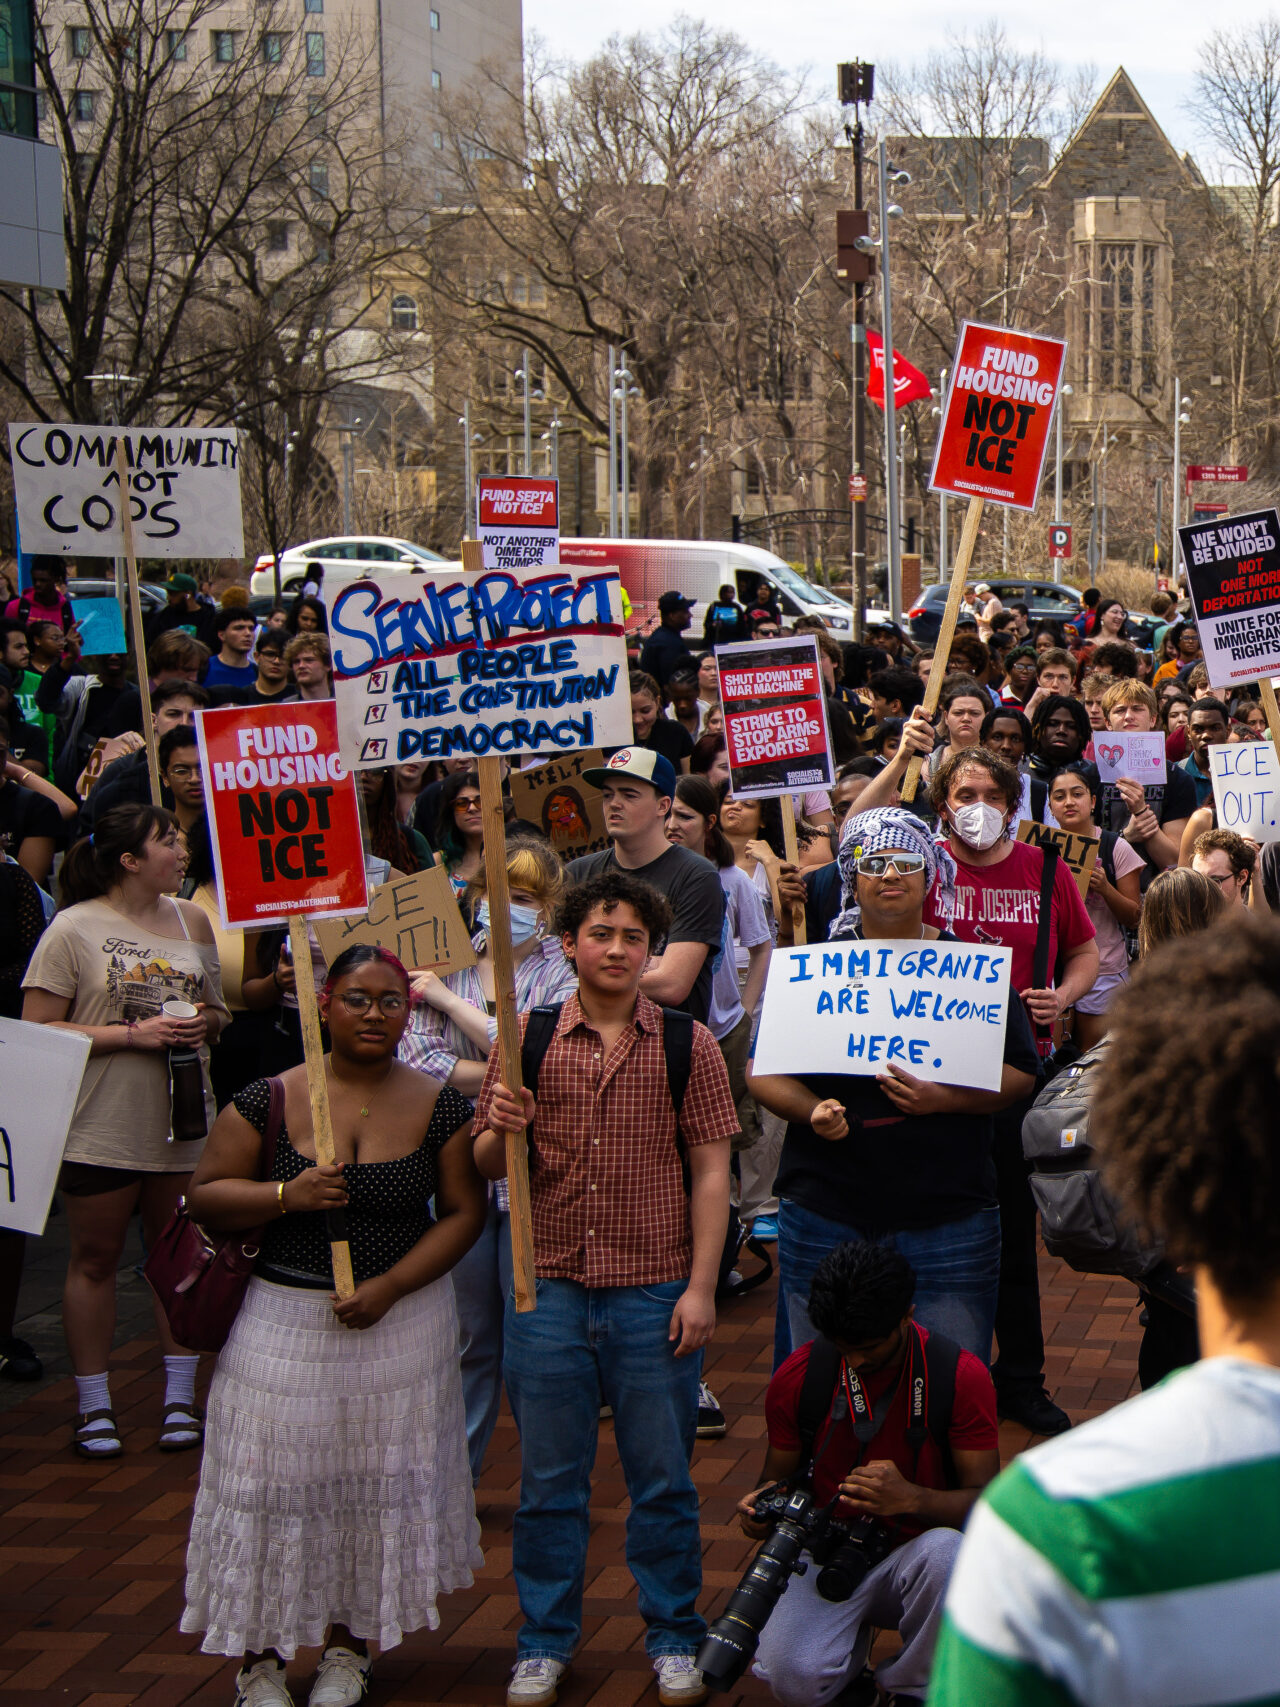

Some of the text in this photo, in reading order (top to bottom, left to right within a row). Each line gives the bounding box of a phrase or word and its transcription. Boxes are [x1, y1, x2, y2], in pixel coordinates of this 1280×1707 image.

[981, 346, 1039, 377] FUND
[956, 366, 1054, 406] HOUSING
[963, 394, 1036, 439] NOT
[966, 432, 1018, 475] ICE
[102, 470, 179, 496] NOT
[481, 489, 554, 503] FUND SEPTA
[984, 485, 1015, 498] ALTERNATIVE
[43, 495, 180, 538] COPS
[493, 502, 544, 515] NOT ICE!
[483, 535, 556, 547] NOT ANOTHER
[1055, 532, 1067, 544] D
[1191, 520, 1268, 549] WE WON'T
[495, 546, 544, 557] DIME FOR
[497, 556, 543, 567] TRUMP'S
[1192, 535, 1276, 565] BE DIVIDED
[1237, 557, 1264, 574] NOT
[1220, 576, 1248, 594] ONE
[331, 581, 470, 676] SERVE
[475, 572, 620, 647] PROTECT
[1215, 617, 1256, 636] UNITE
[1232, 640, 1280, 661] RIGHTS
[392, 660, 455, 693] ALL
[458, 639, 578, 685] PEOPLE
[724, 668, 813, 685] SHUT DOWN THE
[1230, 667, 1256, 678] SOCIALIST
[393, 688, 457, 719] THE
[459, 665, 619, 714] CONSTITUTION
[726, 680, 804, 697] WAR MACHINE
[730, 707, 806, 734] STRIKE TO
[733, 720, 820, 748] STOP ARMS
[238, 725, 318, 757] FUND
[397, 711, 593, 761] DEMOCRACY
[736, 737, 809, 763] EXPORTS!
[214, 753, 348, 791] HOUSING
[524, 756, 584, 790] MELT
[787, 769, 816, 778] SOCIALIST
[1216, 747, 1271, 777] ICE
[788, 776, 824, 786] ALTERNATIVE
[238, 786, 333, 837] NOT
[1223, 790, 1276, 826] OUT.
[258, 833, 328, 883] ICE
[1025, 824, 1099, 867] MELT
[255, 895, 341, 913] SOCIALIST ALTERNATIVE
[342, 880, 424, 938] CE
[934, 884, 976, 921] SNT
[102, 937, 151, 959] Ford
[789, 948, 1004, 984] IMMIGRANTS
[817, 988, 1002, 1025] ARE WELCOME
[847, 1033, 943, 1069] HERE.
[853, 1394, 866, 1413] 60D
[914, 1377, 924, 1416] Canon
